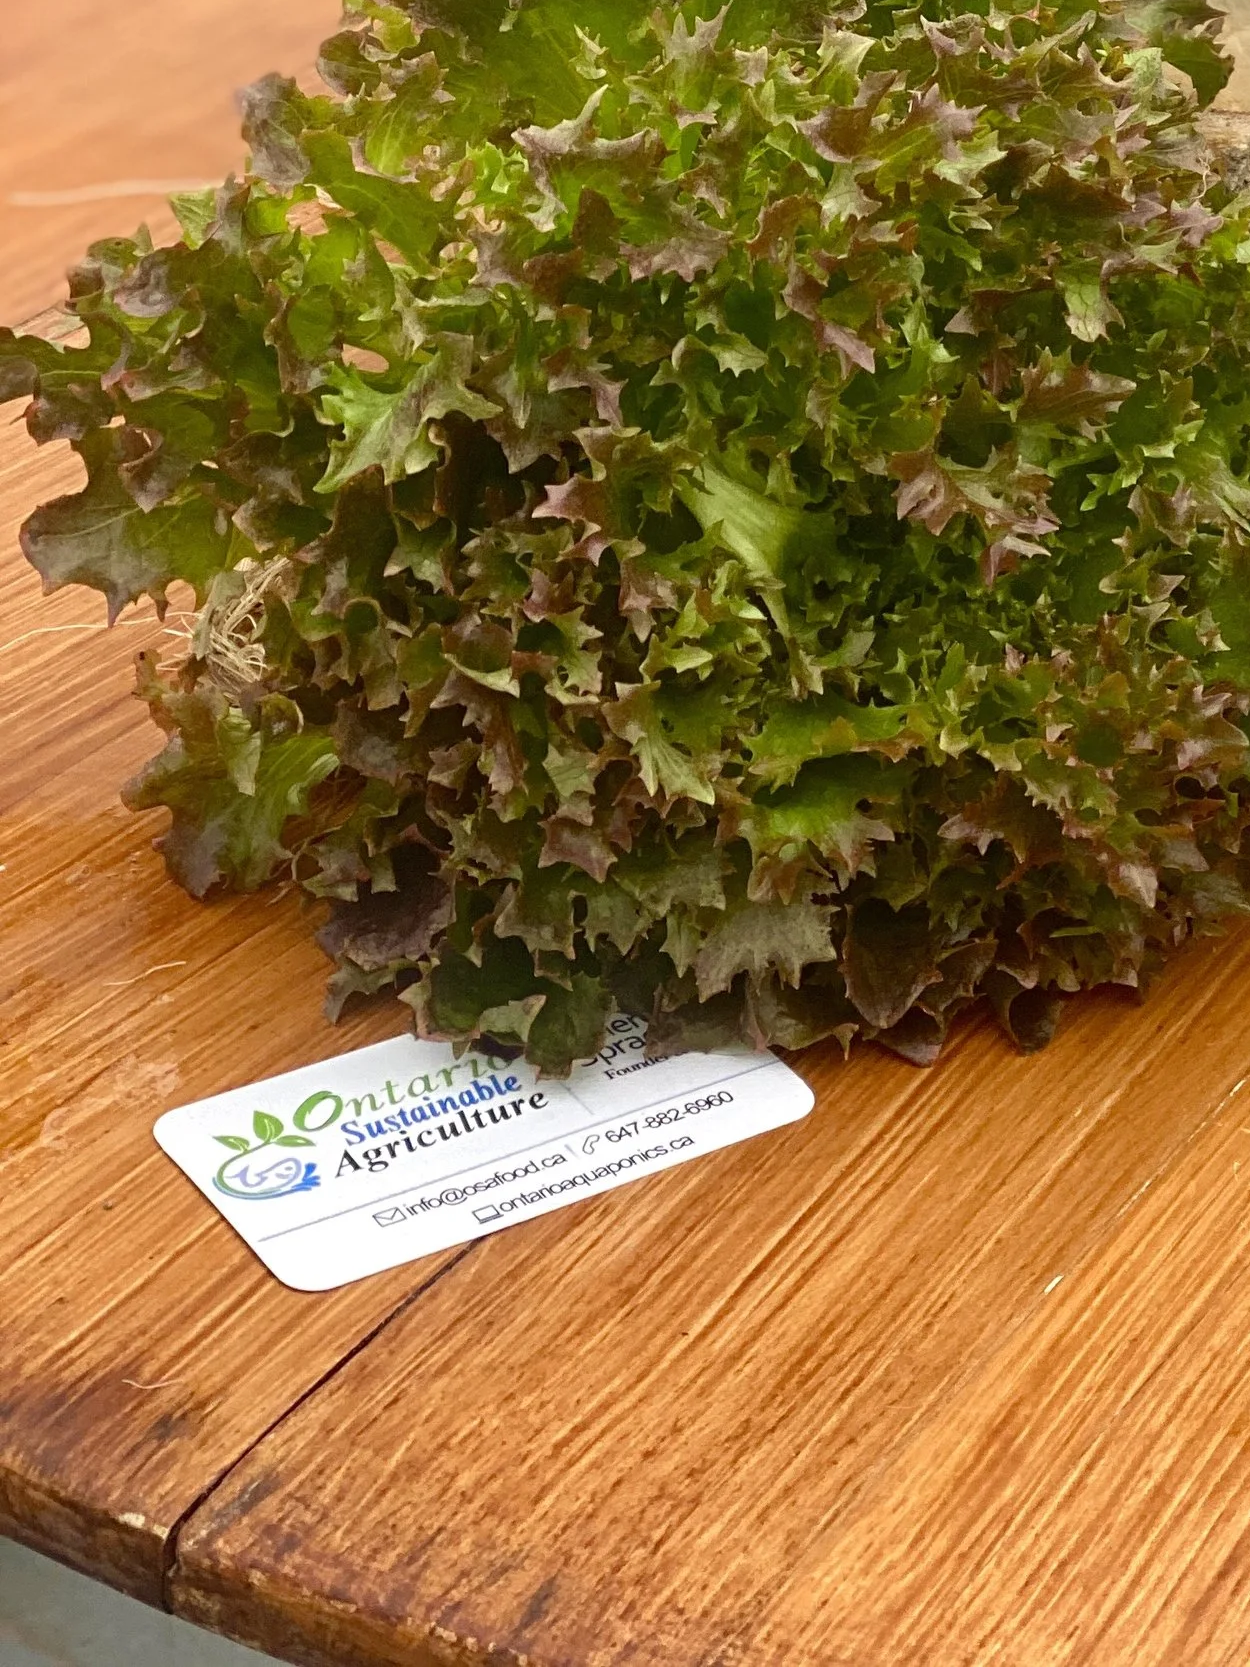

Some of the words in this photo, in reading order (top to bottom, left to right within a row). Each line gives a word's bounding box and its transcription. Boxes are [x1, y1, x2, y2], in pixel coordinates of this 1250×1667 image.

[293, 1055, 512, 1132] Ontario
[340, 1074, 522, 1145] Sustainable
[335, 1092, 549, 1178] Agriculture
[405, 1151, 568, 1216] info@osafood.ca
[605, 1090, 734, 1143] 647-882-6960
[500, 1134, 695, 1213] ontarioaquaponics.ca
